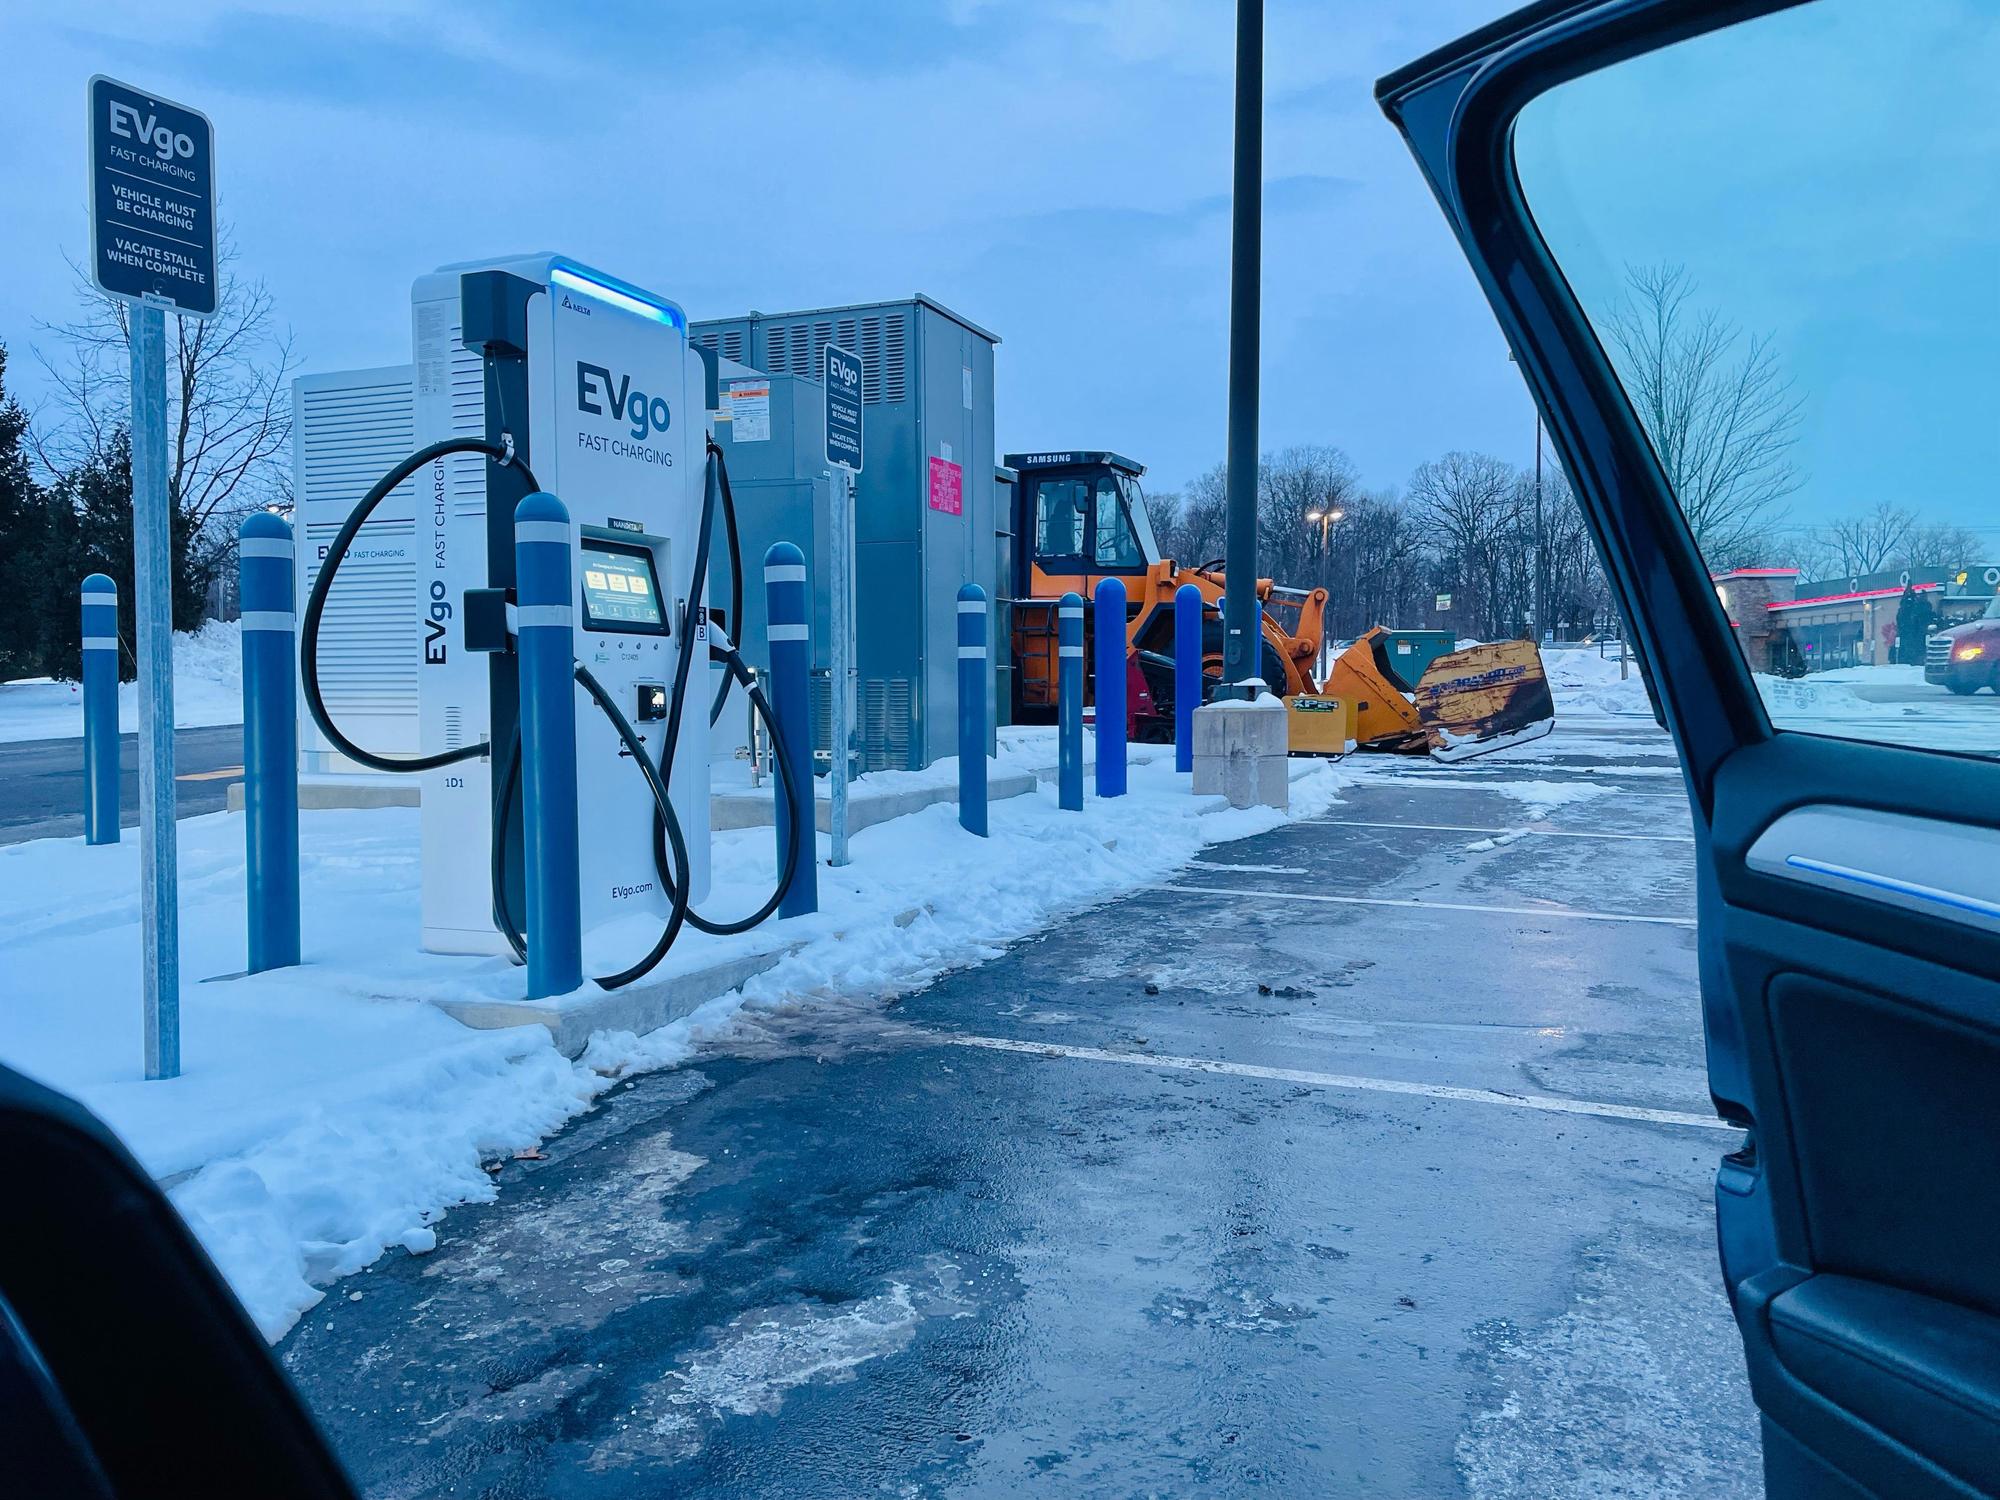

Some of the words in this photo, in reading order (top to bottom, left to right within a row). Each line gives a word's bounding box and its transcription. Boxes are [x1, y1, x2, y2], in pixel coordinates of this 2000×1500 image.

[109, 100, 195, 160] EVgo
[111, 145, 136, 163] FAST
[139, 155, 196, 182] CHARGING
[111, 184, 161, 208] VEHICLE
[165, 200, 196, 218] MUST
[116, 199, 131, 213] BE
[133, 204, 193, 231] CHARGING
[107, 248, 143, 268] WHEN
[145, 258, 205, 284] COMPLETE
[115, 237, 161, 260] VACATE
[163, 251, 197, 269] STALL
[830, 356, 858, 387] EVgo
[577, 361, 671, 440] EVgo
[578, 432, 609, 453] FAST
[611, 440, 673, 467] CHARGING
[1026, 454, 1071, 464] SAMSUNG
[434, 440, 446, 527] CHARGIN
[354, 550, 370, 559] FAST
[370, 549, 405, 558] CHARGING
[434, 530, 446, 569] FAST
[424, 580, 453, 665] EVgo
[700, 627, 705, 638] B
[445, 778, 464, 788] 1D1
[612, 881, 653, 899] EVgo.com
